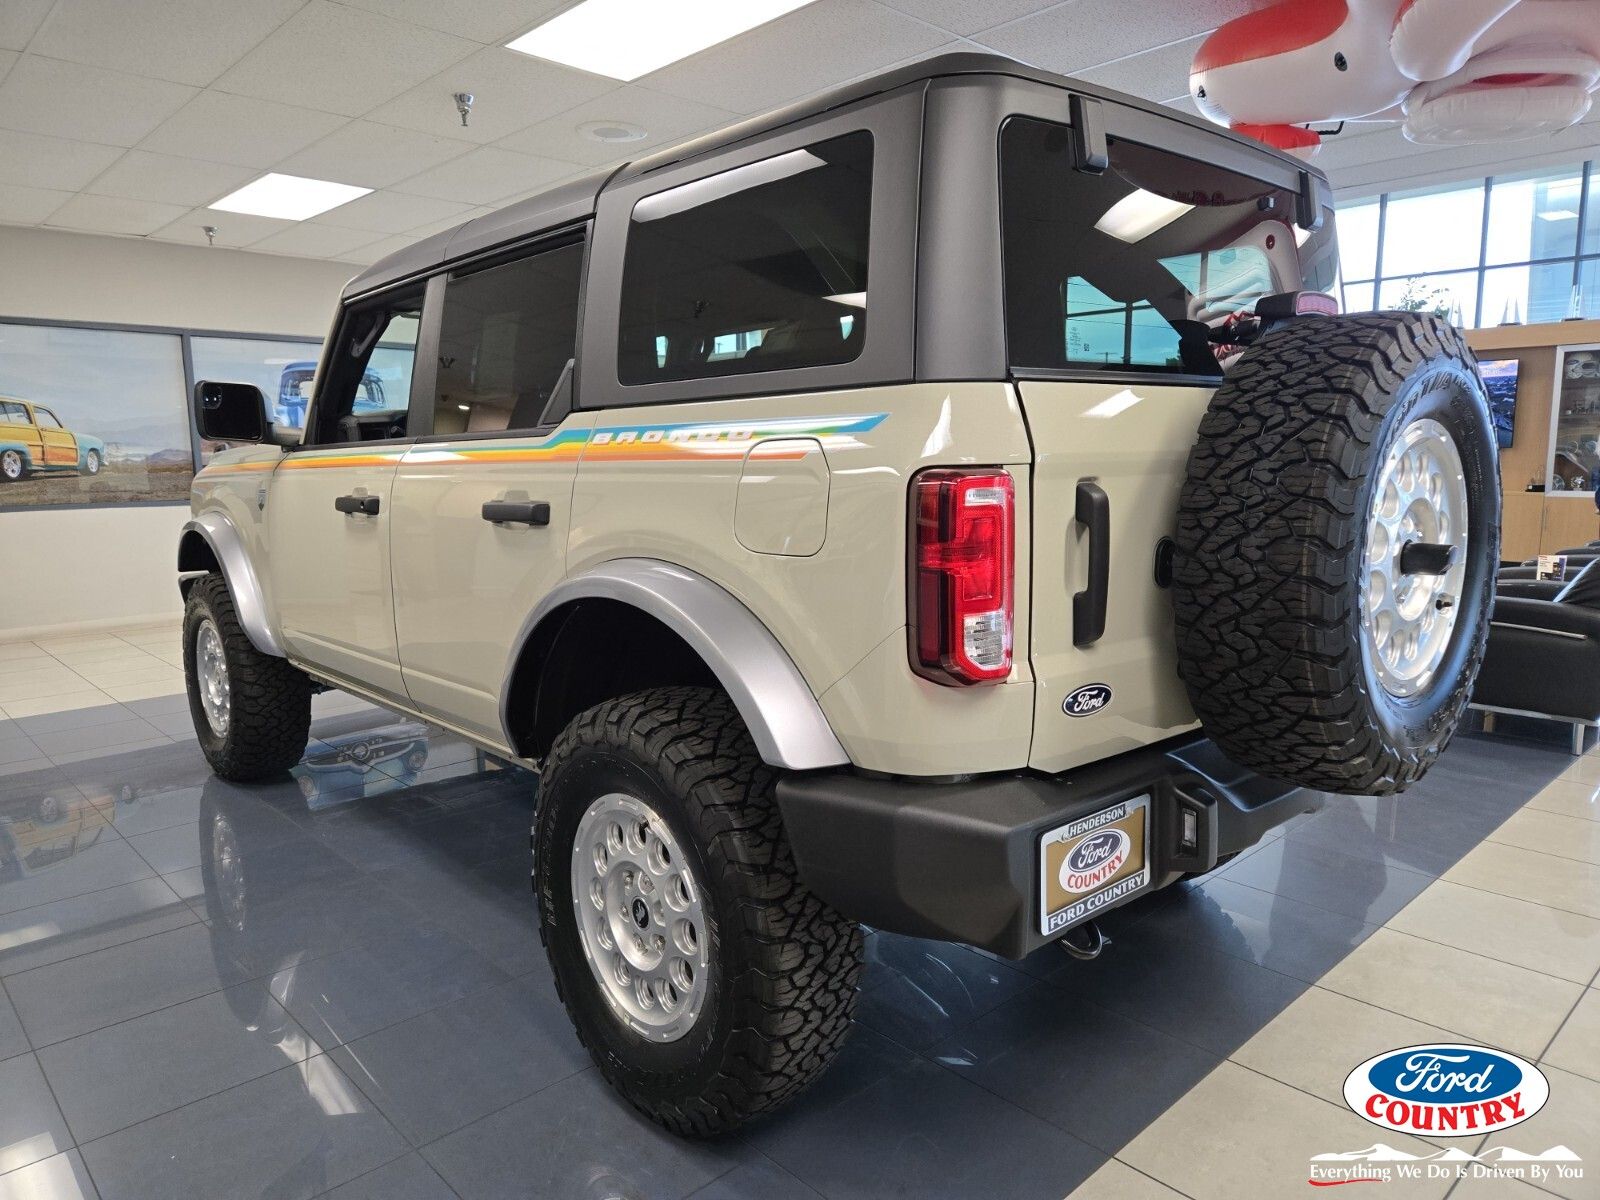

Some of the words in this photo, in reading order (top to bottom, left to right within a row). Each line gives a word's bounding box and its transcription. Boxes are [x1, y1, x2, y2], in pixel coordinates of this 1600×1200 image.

[592, 430, 754, 446] BRONCO
[1074, 689, 1106, 712] Ford
[1069, 806, 1125, 836] HENDERSON
[1077, 836, 1113, 868] Ford
[1067, 851, 1123, 889] COUNTRY
[1050, 905, 1085, 929] FORD
[1086, 873, 1144, 910] COUNTRY
